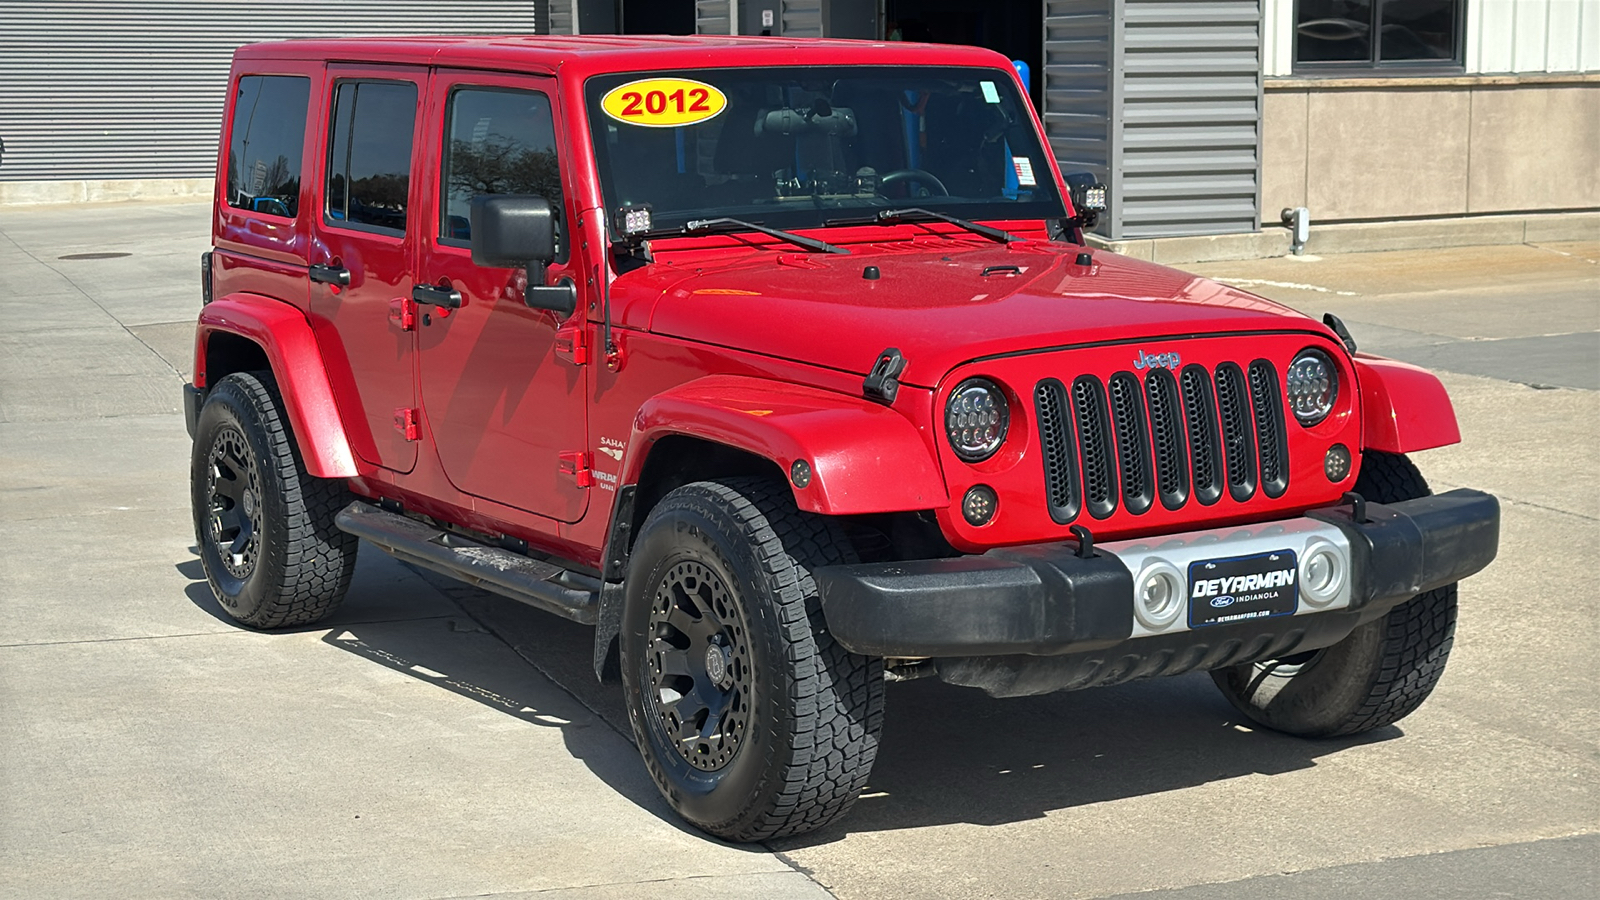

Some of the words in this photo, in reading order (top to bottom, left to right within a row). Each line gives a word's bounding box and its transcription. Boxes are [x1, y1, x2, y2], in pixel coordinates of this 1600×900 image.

[620, 88, 711, 116] 2012
[1132, 349, 1181, 370] Jeep
[1192, 568, 1295, 598] DEYARMAN
[1236, 591, 1279, 603] INDIANOLA
[1217, 610, 1270, 623] DEYARMANFORD.COM
